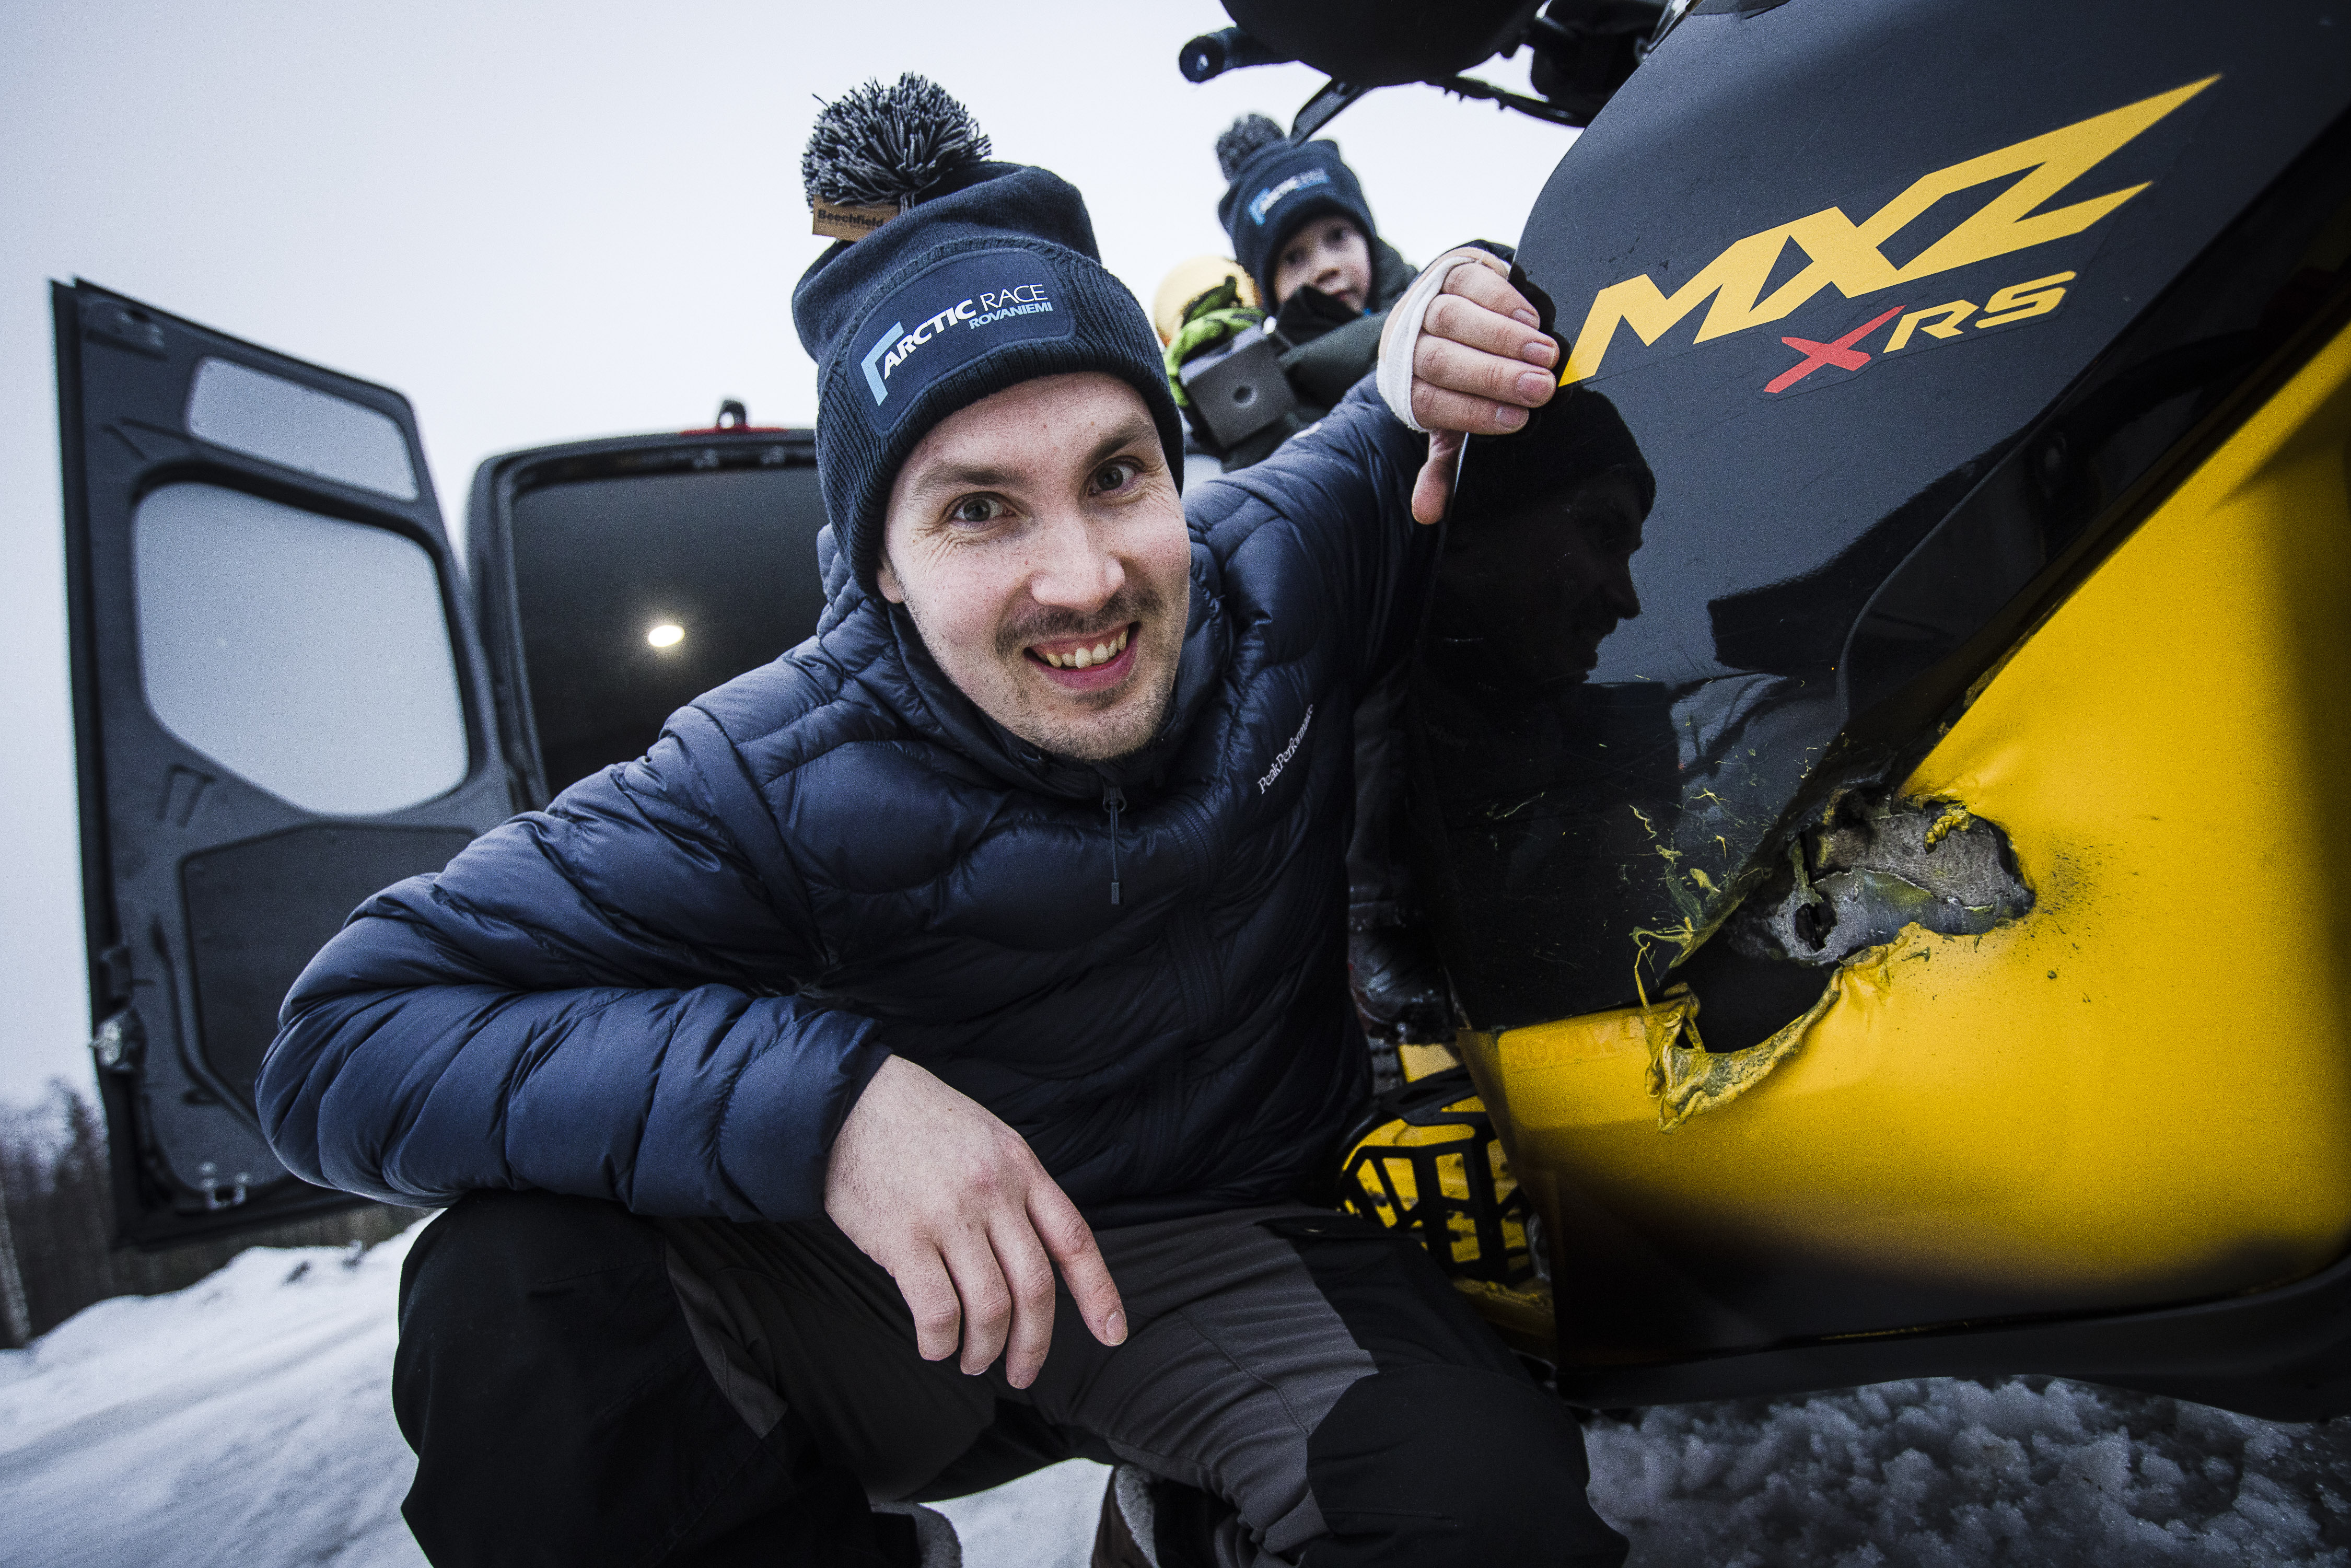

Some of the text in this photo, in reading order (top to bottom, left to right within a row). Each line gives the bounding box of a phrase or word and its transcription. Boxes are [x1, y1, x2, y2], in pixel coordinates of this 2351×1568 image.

[818, 210, 884, 227] Beechfield
[1558, 73, 2222, 387] MXZ
[884, 284, 1048, 380] ARCTIC RACE
[969, 301, 1053, 330] ROVANIEMI
